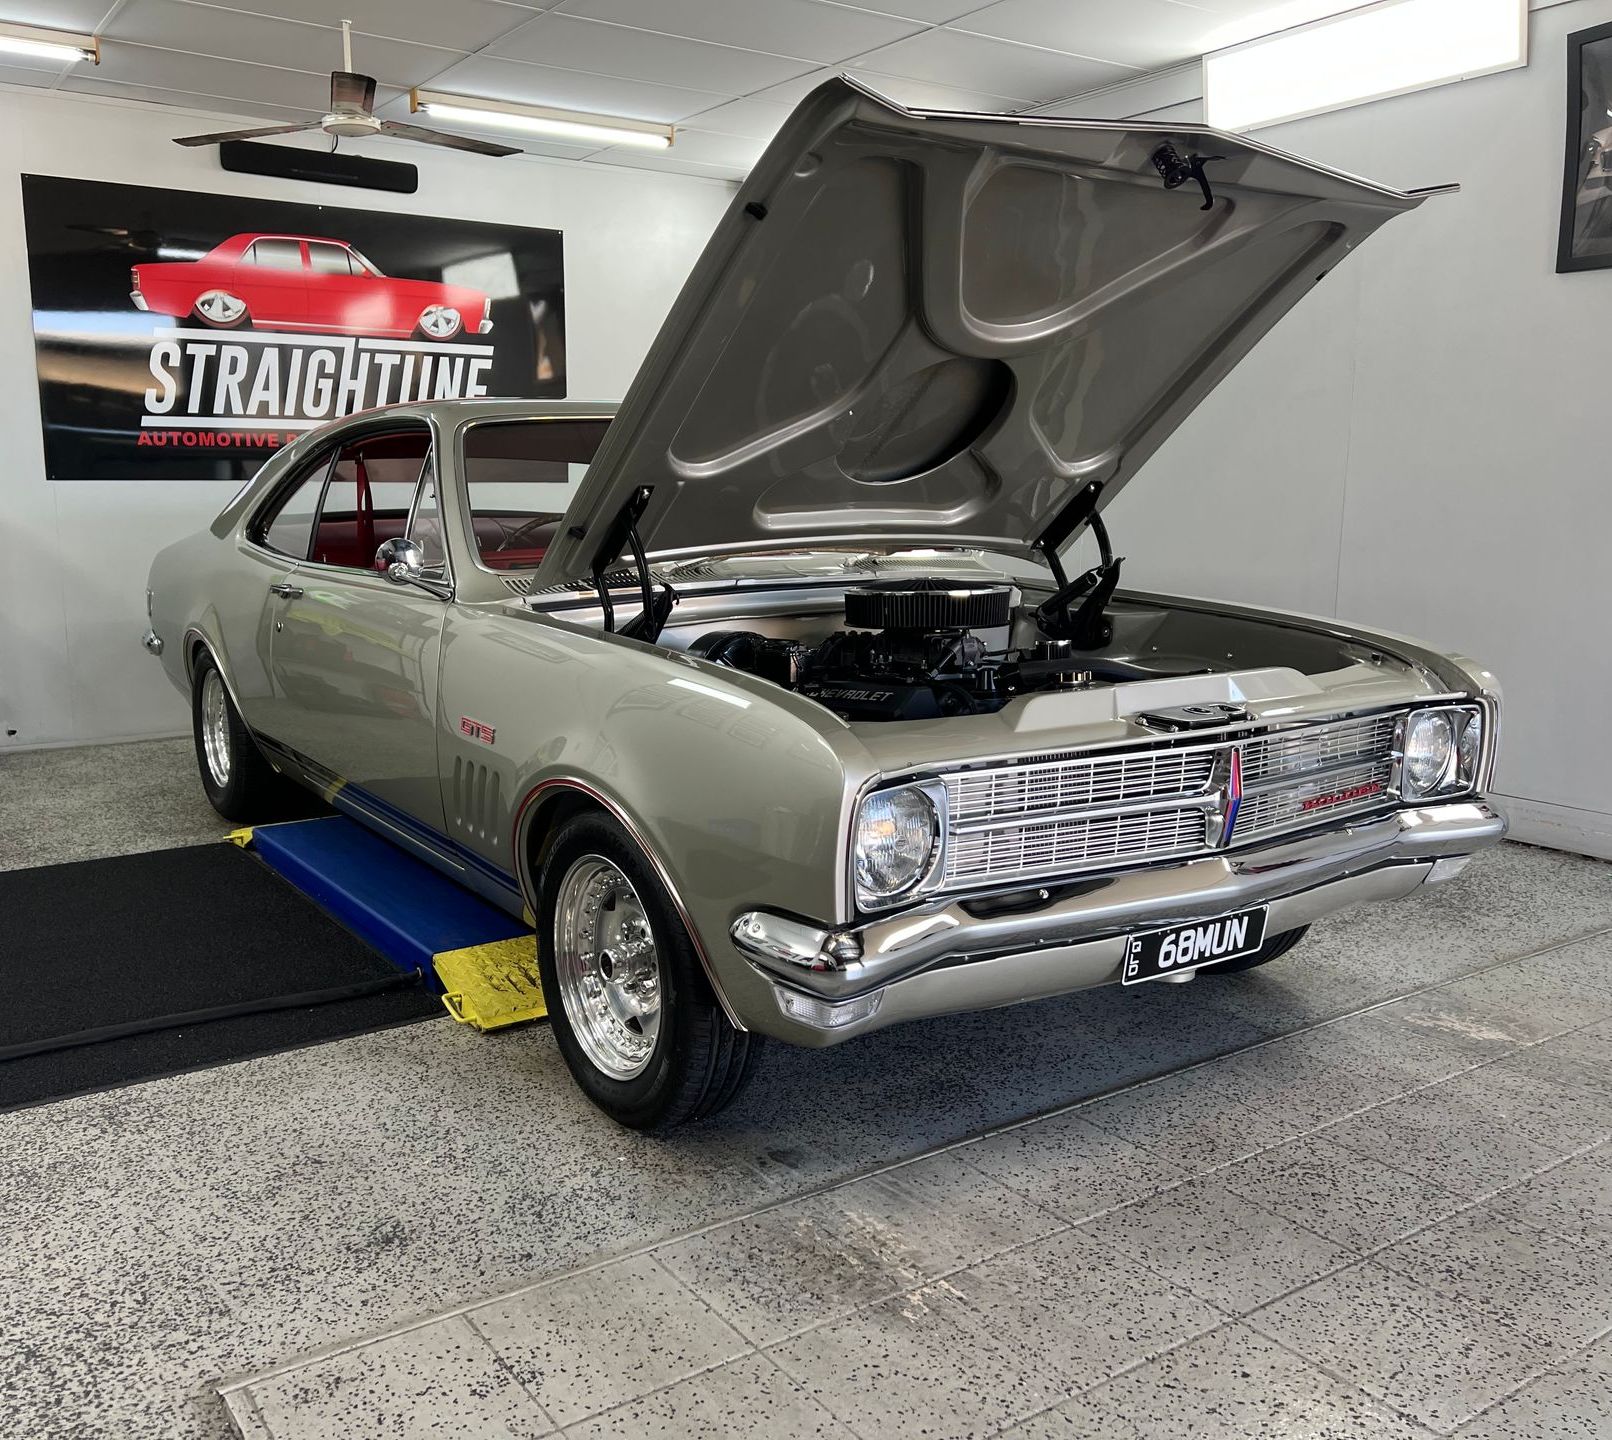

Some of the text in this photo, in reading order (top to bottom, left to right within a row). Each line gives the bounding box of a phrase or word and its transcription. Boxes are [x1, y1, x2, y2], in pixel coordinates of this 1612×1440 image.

[137, 431, 280, 449] AUTOMOTIVE
[460, 716, 496, 745] GTS
[1158, 915, 1249, 969] 68MUN
[1127, 941, 1142, 977] QLD
